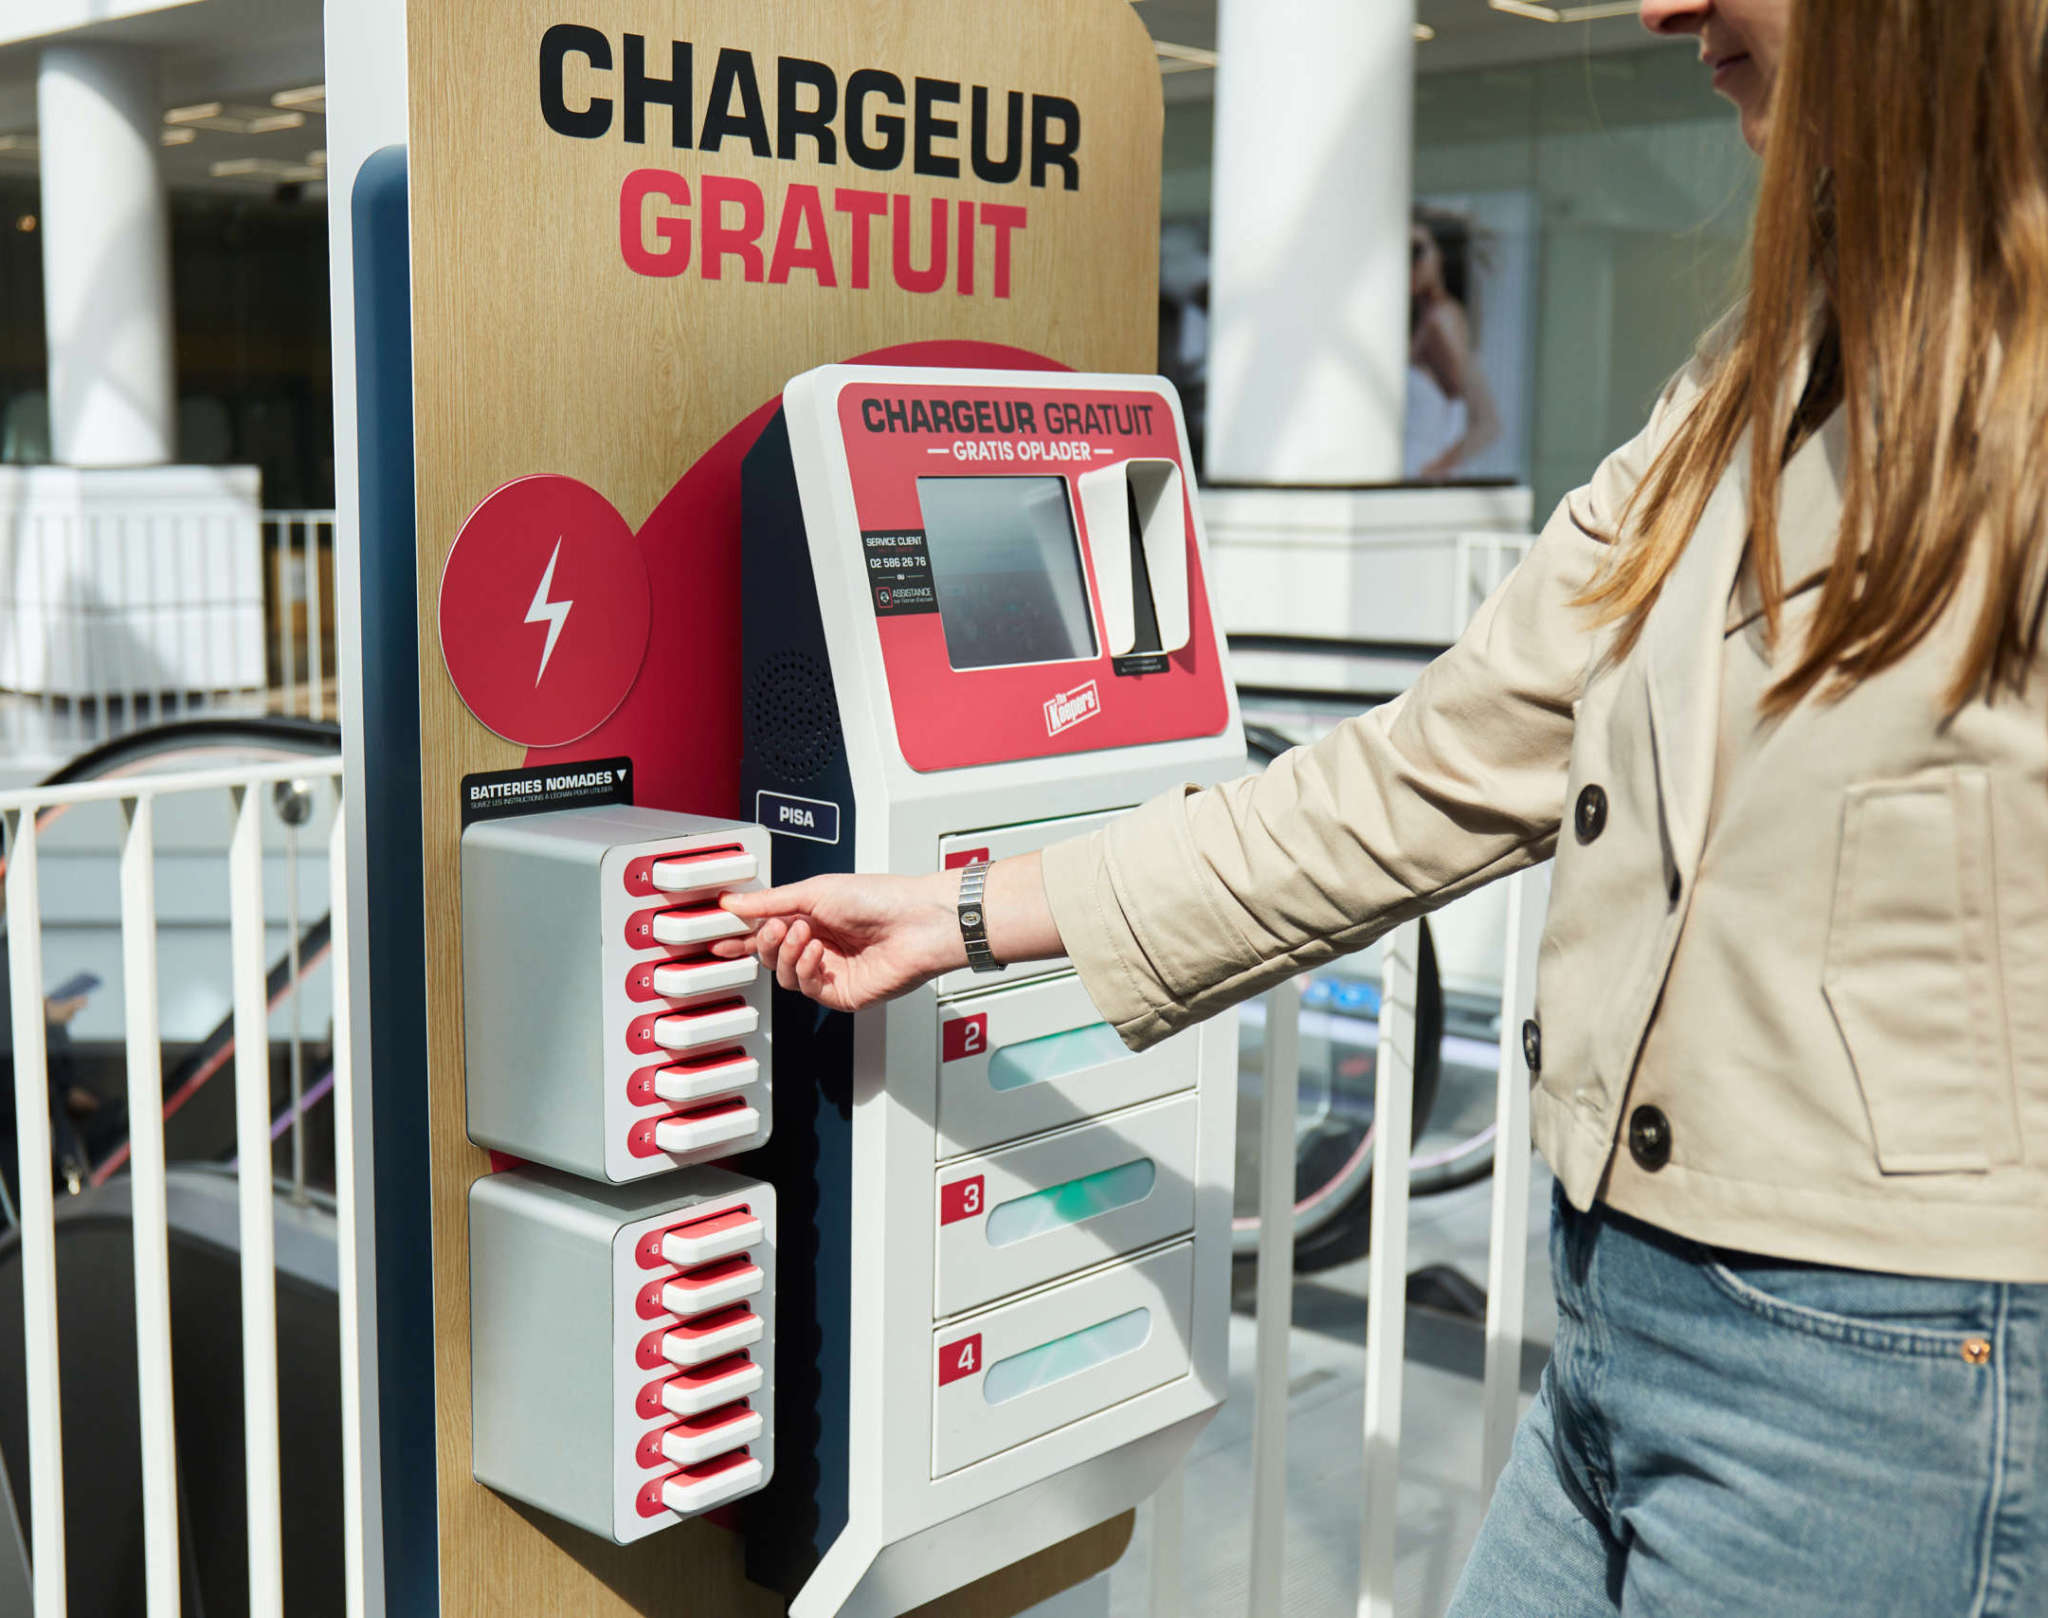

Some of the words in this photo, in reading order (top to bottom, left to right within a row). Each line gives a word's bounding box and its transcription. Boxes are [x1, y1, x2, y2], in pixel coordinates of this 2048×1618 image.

[538, 23, 1081, 192] CHARGEUR
[619, 167, 1027, 299] GRATUIT
[861, 398, 1037, 434] CHARGEUR
[1043, 402, 1154, 436] GRATUIT
[953, 440, 1014, 462] GRATIS
[1017, 441, 1092, 461] OPLADER
[866, 537, 896, 547] SERVICE
[897, 535, 922, 546] CLIENT
[870, 558, 882, 569] 02
[902, 557, 914, 568] 26
[914, 556, 927, 567] 76
[1048, 689, 1095, 731] Keepers
[470, 779, 542, 800] BATTERIES
[546, 770, 613, 792] NOMADES
[779, 805, 815, 828] PISA
[641, 871, 649, 882] A
[641, 924, 649, 935] B
[642, 976, 650, 987] C
[643, 1028, 651, 1039] D
[964, 1021, 981, 1052] 2
[643, 1080, 650, 1091] E
[963, 1184, 979, 1213] 3
[652, 1293, 659, 1305] H
[958, 1342, 975, 1371] 4
